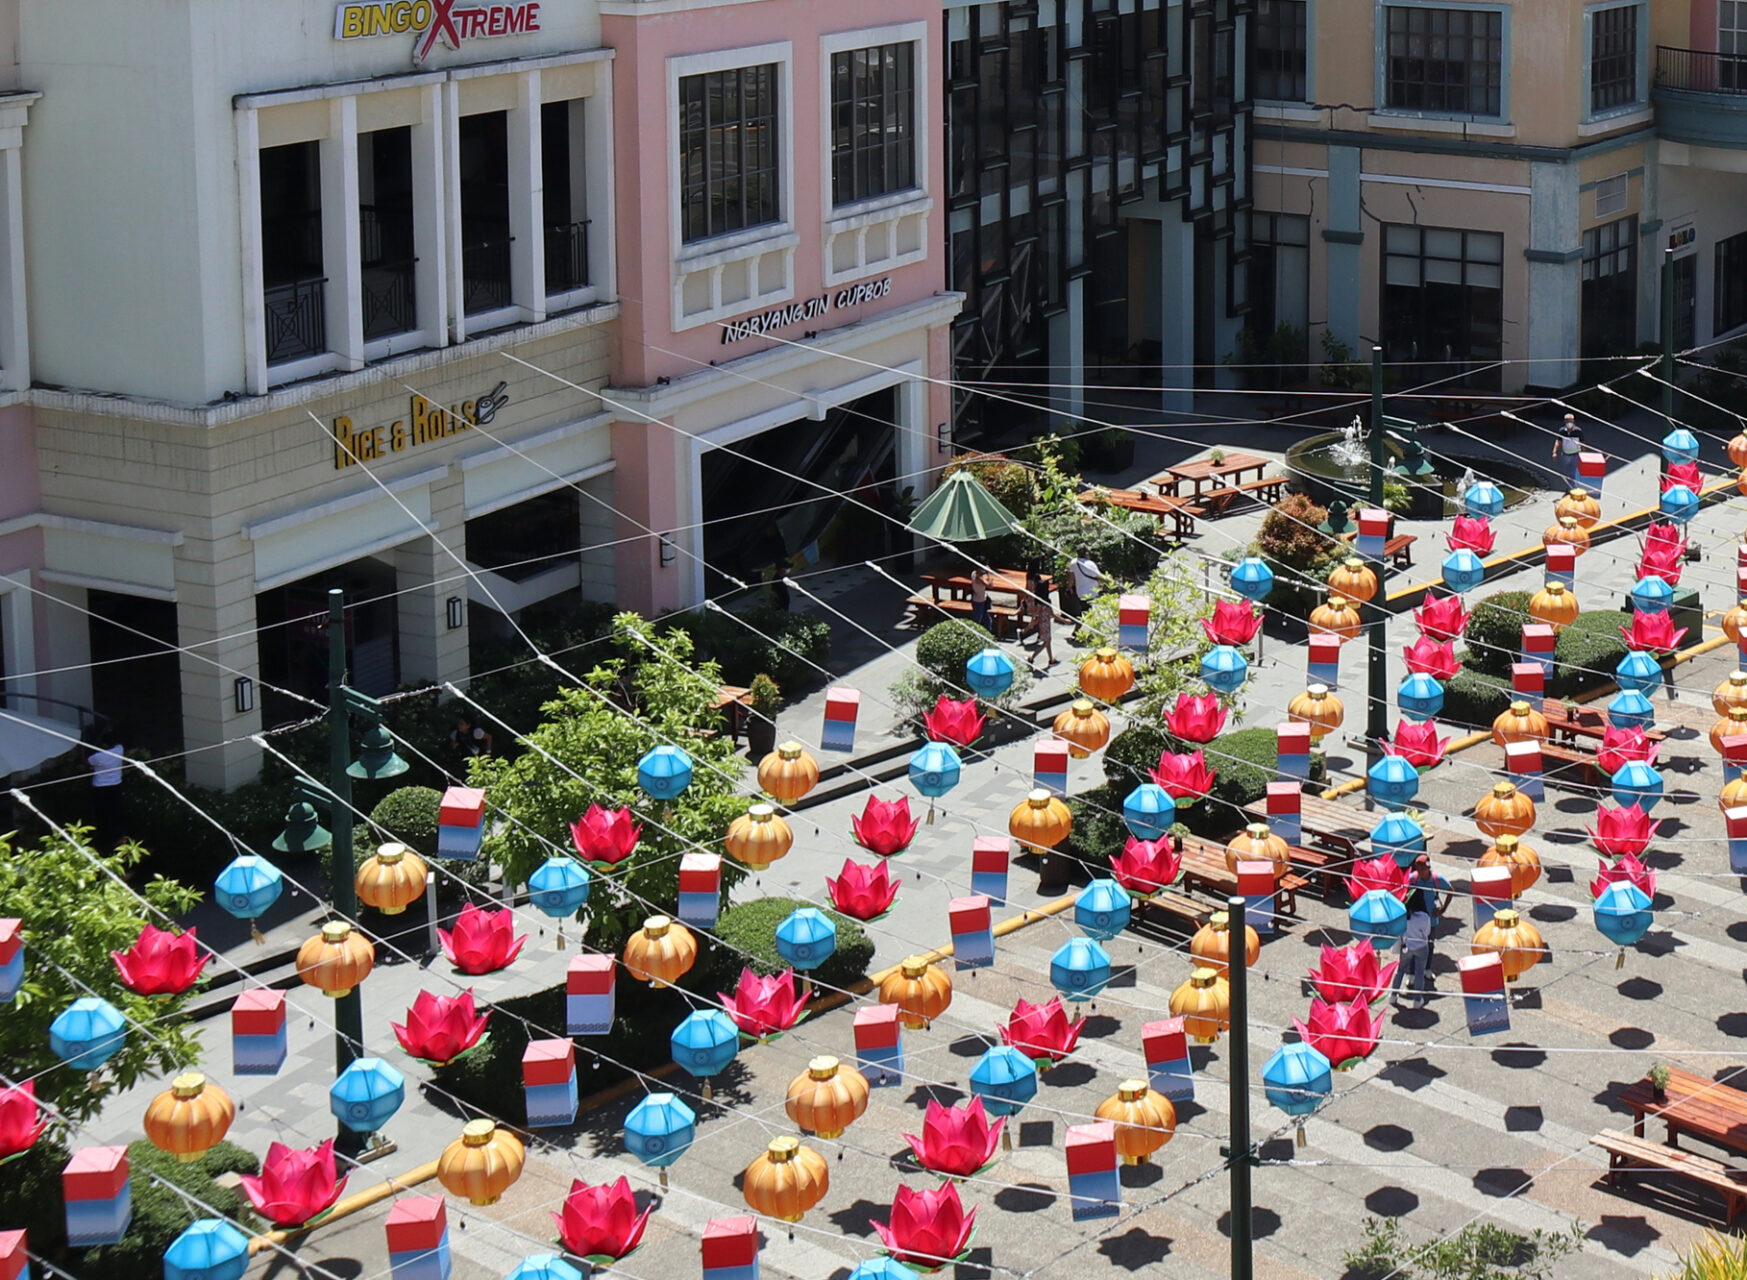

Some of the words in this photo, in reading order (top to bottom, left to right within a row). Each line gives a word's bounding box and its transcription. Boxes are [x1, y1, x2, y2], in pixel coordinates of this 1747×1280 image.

[723, 293, 831, 345] NORYANGJIN
[836, 277, 892, 309] CUPBOB
[391, 420, 406, 453] &
